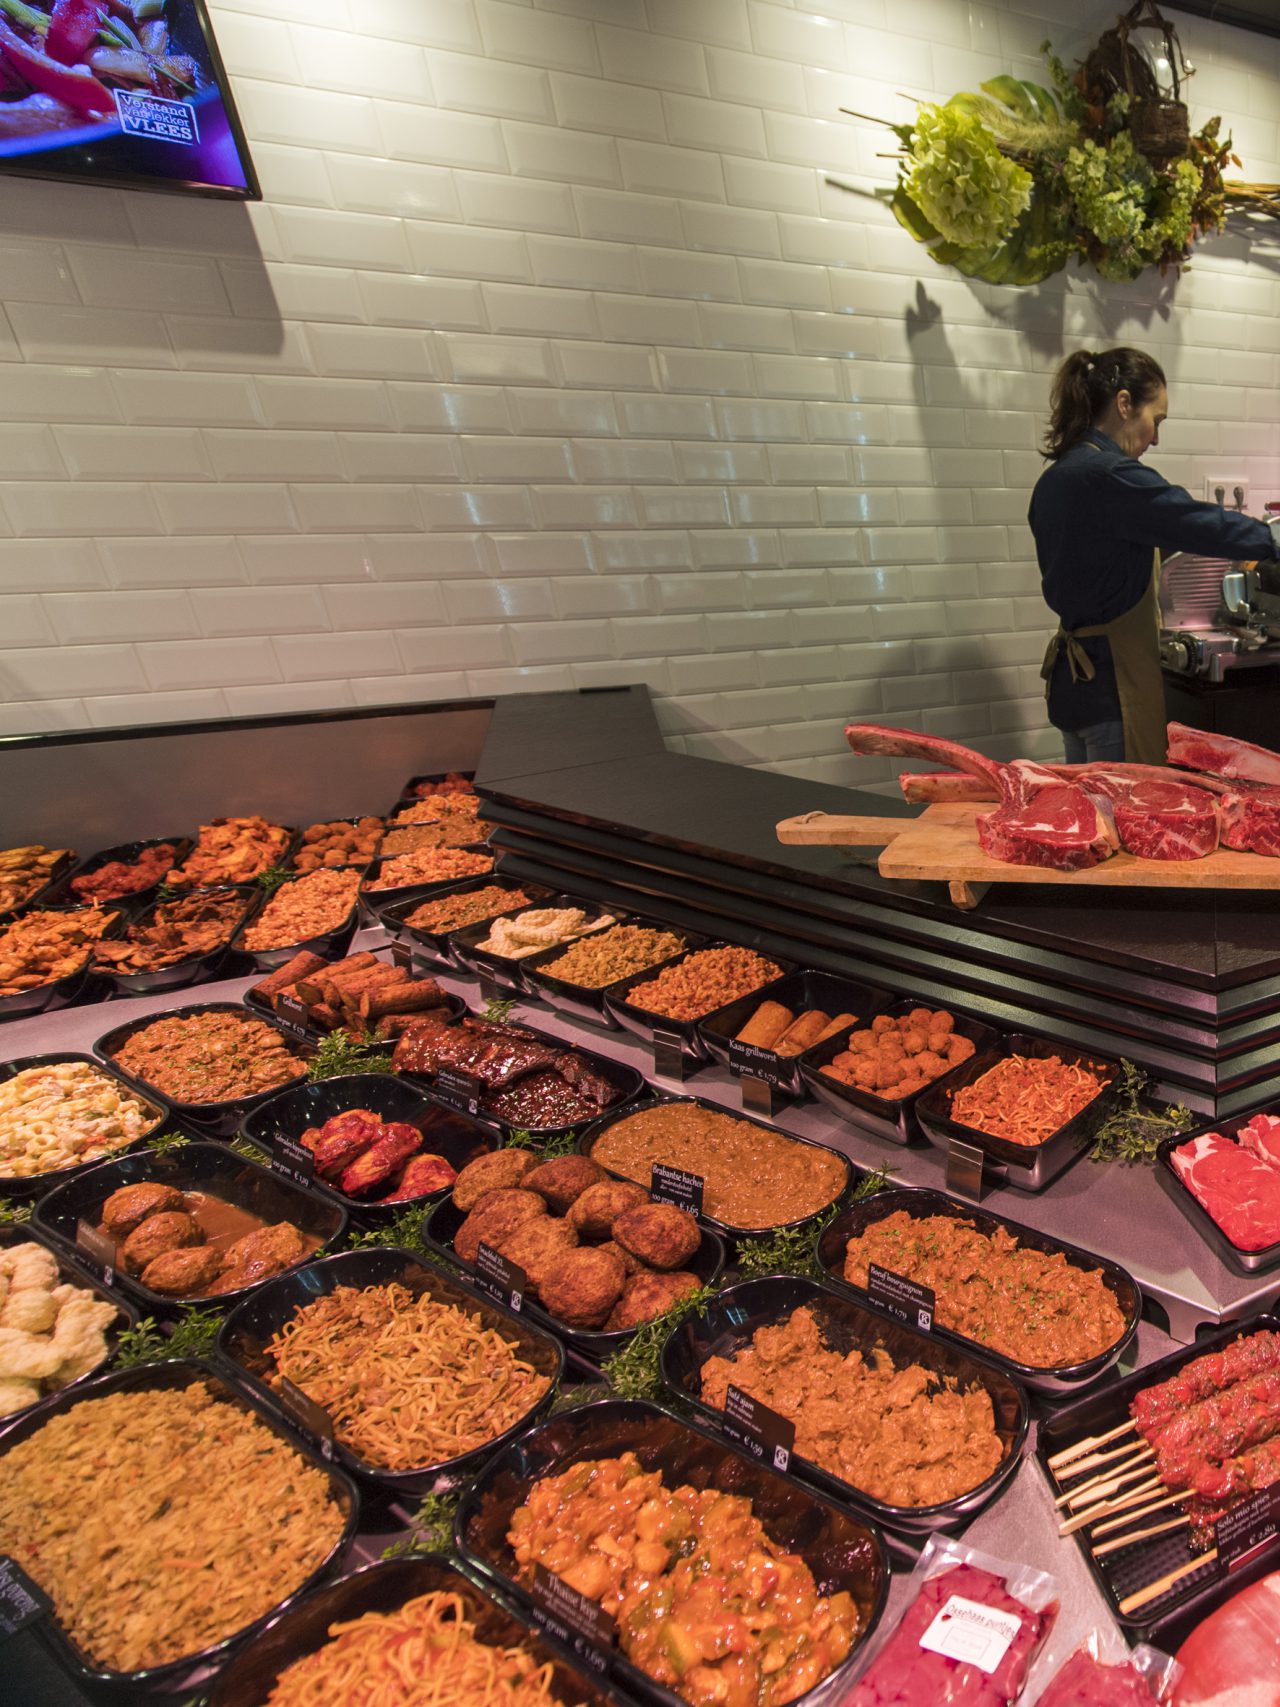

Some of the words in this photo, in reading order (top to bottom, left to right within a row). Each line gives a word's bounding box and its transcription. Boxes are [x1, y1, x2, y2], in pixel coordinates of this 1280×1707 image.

[121, 95, 189, 119] Verstand
[124, 113, 193, 141] VLEES
[729, 1039, 746, 1052] Kaas
[745, 1046, 777, 1063] grillworst
[652, 1163, 682, 1182] Brabantse
[1217, 1512, 1235, 1530] Solo
[1235, 1504, 1251, 1520] mio
[1250, 1493, 1271, 1514] spies
